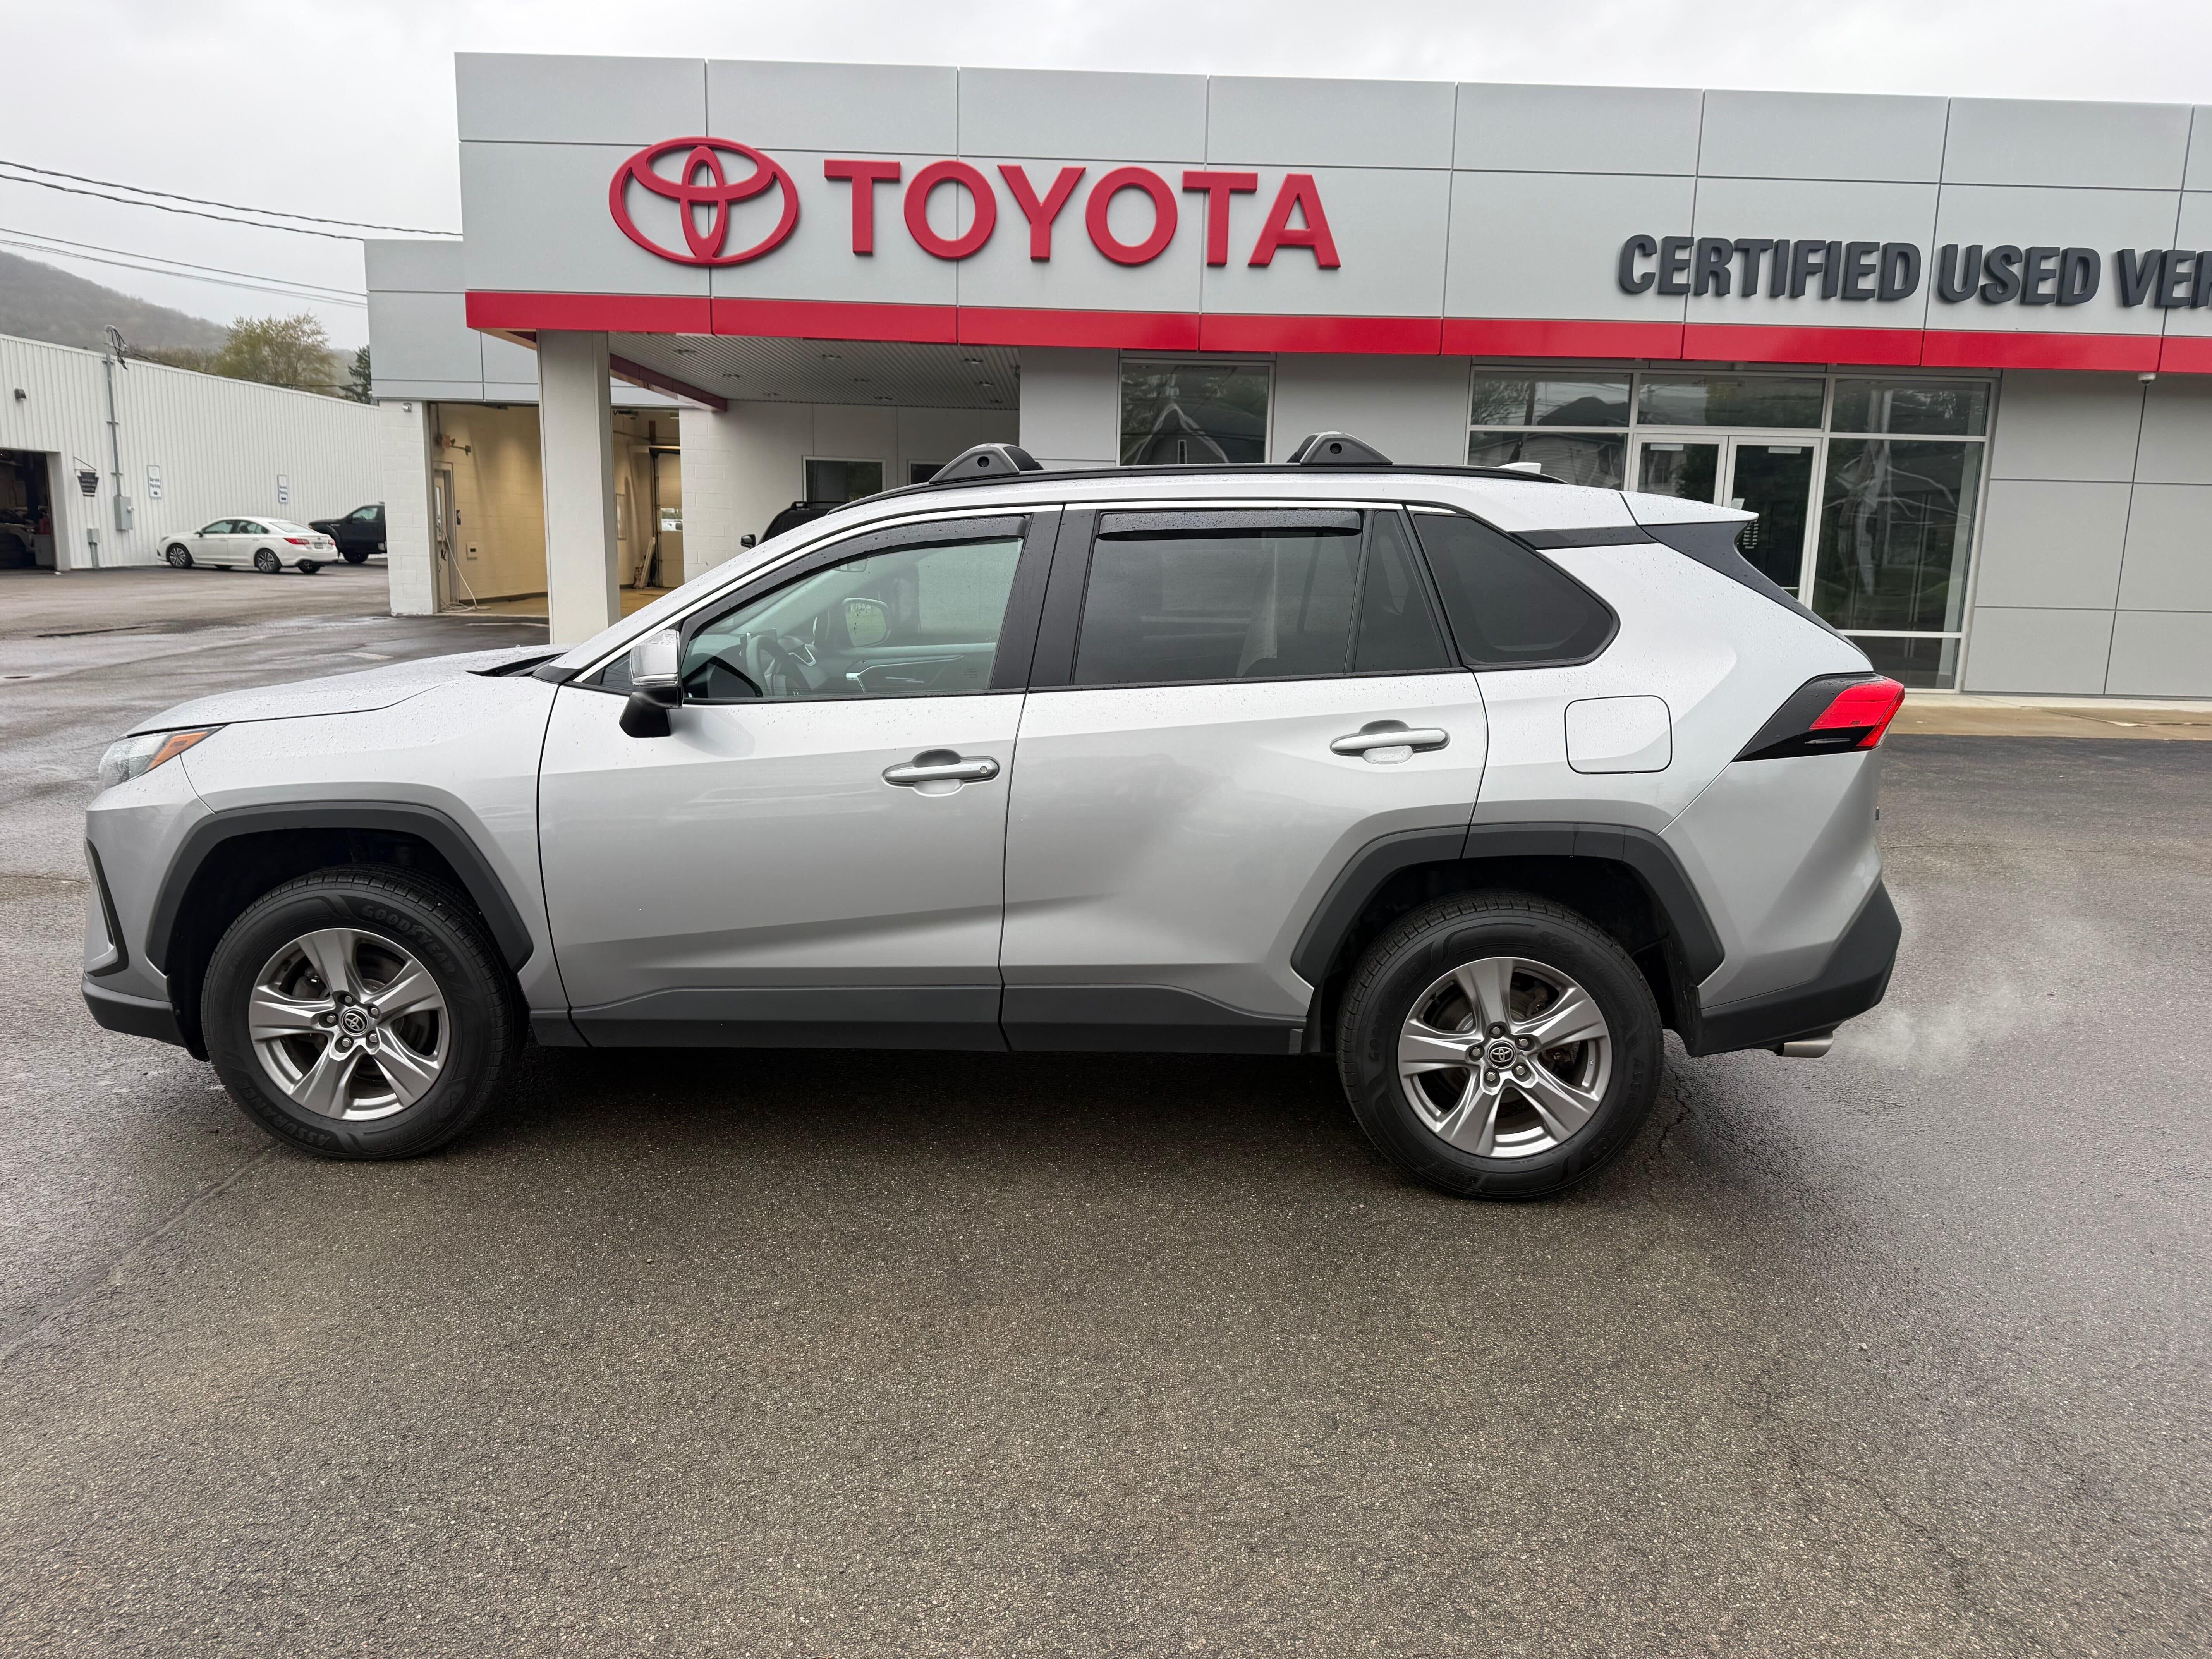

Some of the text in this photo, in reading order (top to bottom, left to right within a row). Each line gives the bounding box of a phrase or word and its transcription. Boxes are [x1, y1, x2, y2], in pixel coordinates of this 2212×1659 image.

[824, 158, 1341, 270] TOYOTA
[1618, 234, 1922, 301] CERTIFIED
[1936, 244, 2102, 306] USED
